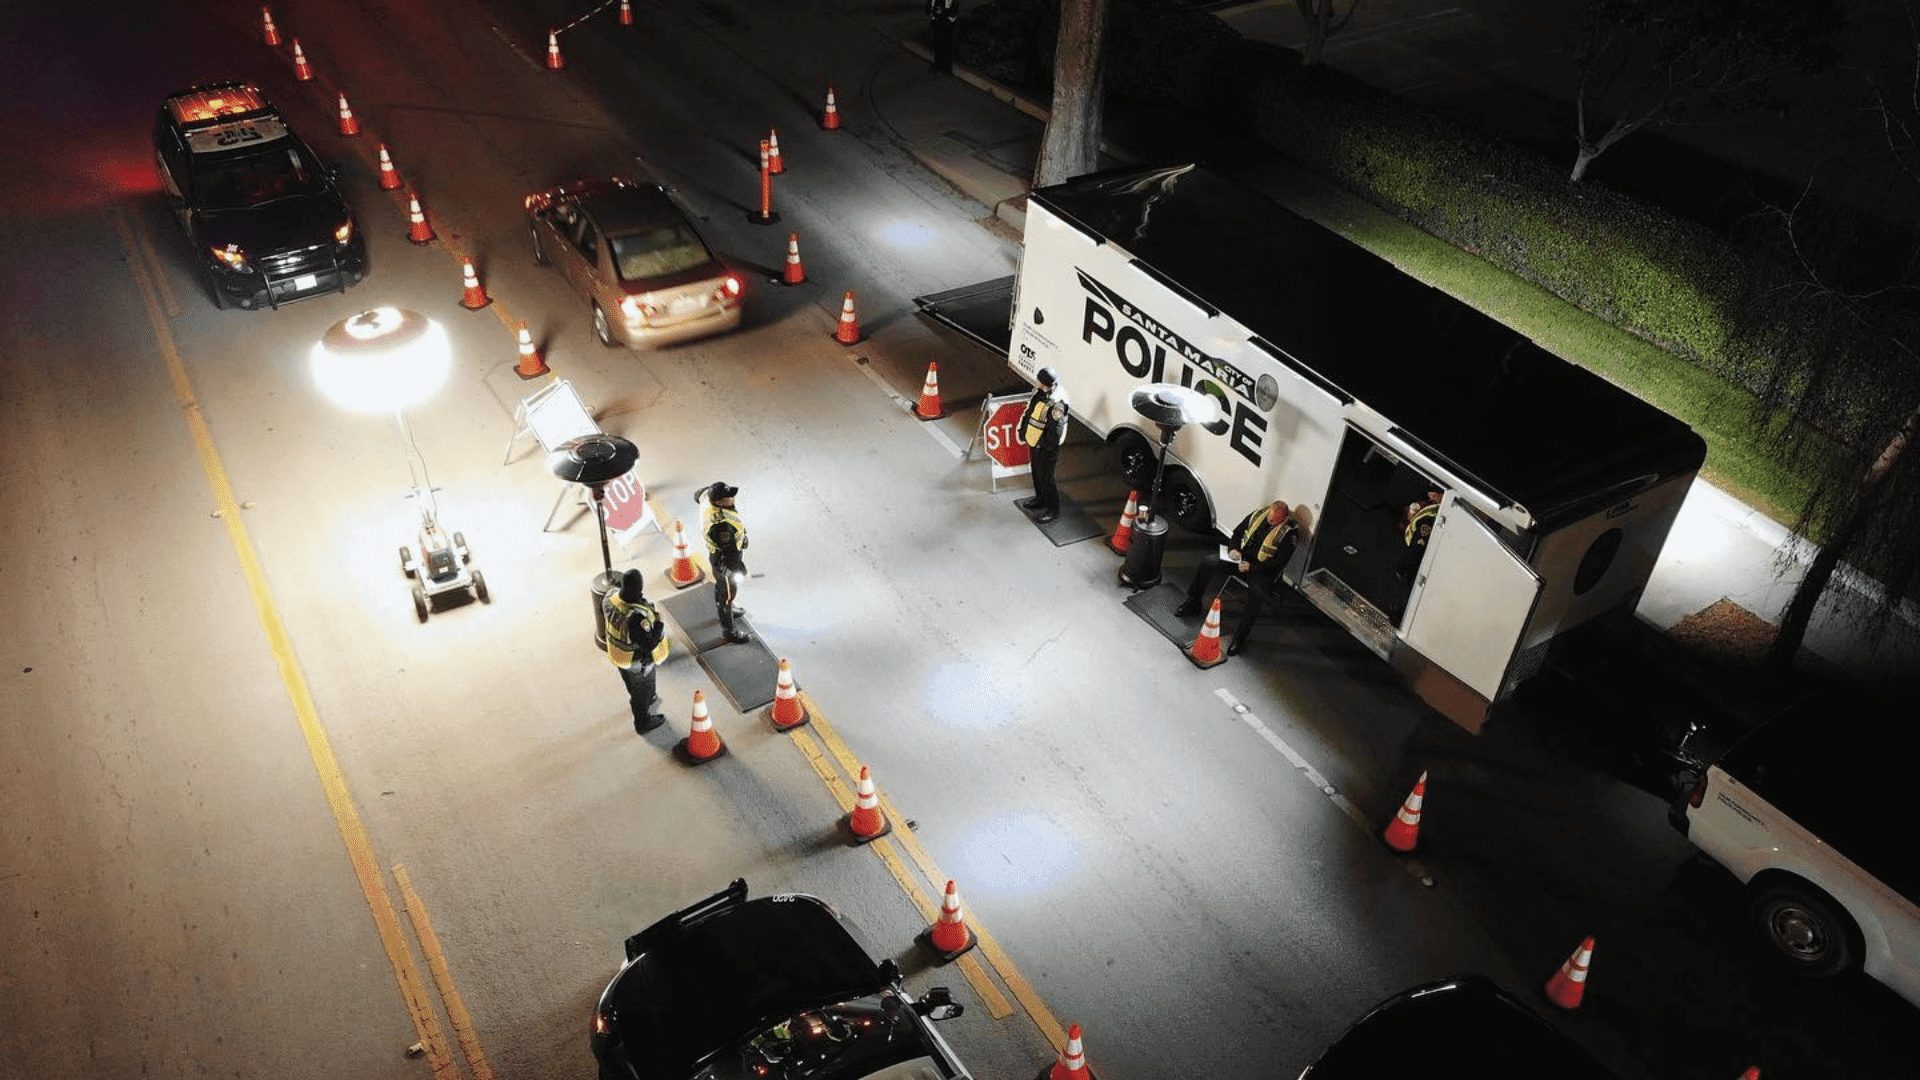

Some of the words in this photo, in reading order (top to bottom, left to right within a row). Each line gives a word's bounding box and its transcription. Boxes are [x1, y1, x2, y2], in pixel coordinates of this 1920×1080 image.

[1122, 303, 1179, 350] SANTA
[1184, 346, 1250, 399] MARIA
[1224, 364, 1242, 379] CITY
[1242, 376, 1254, 386] OF
[987, 423, 1027, 450] STO
